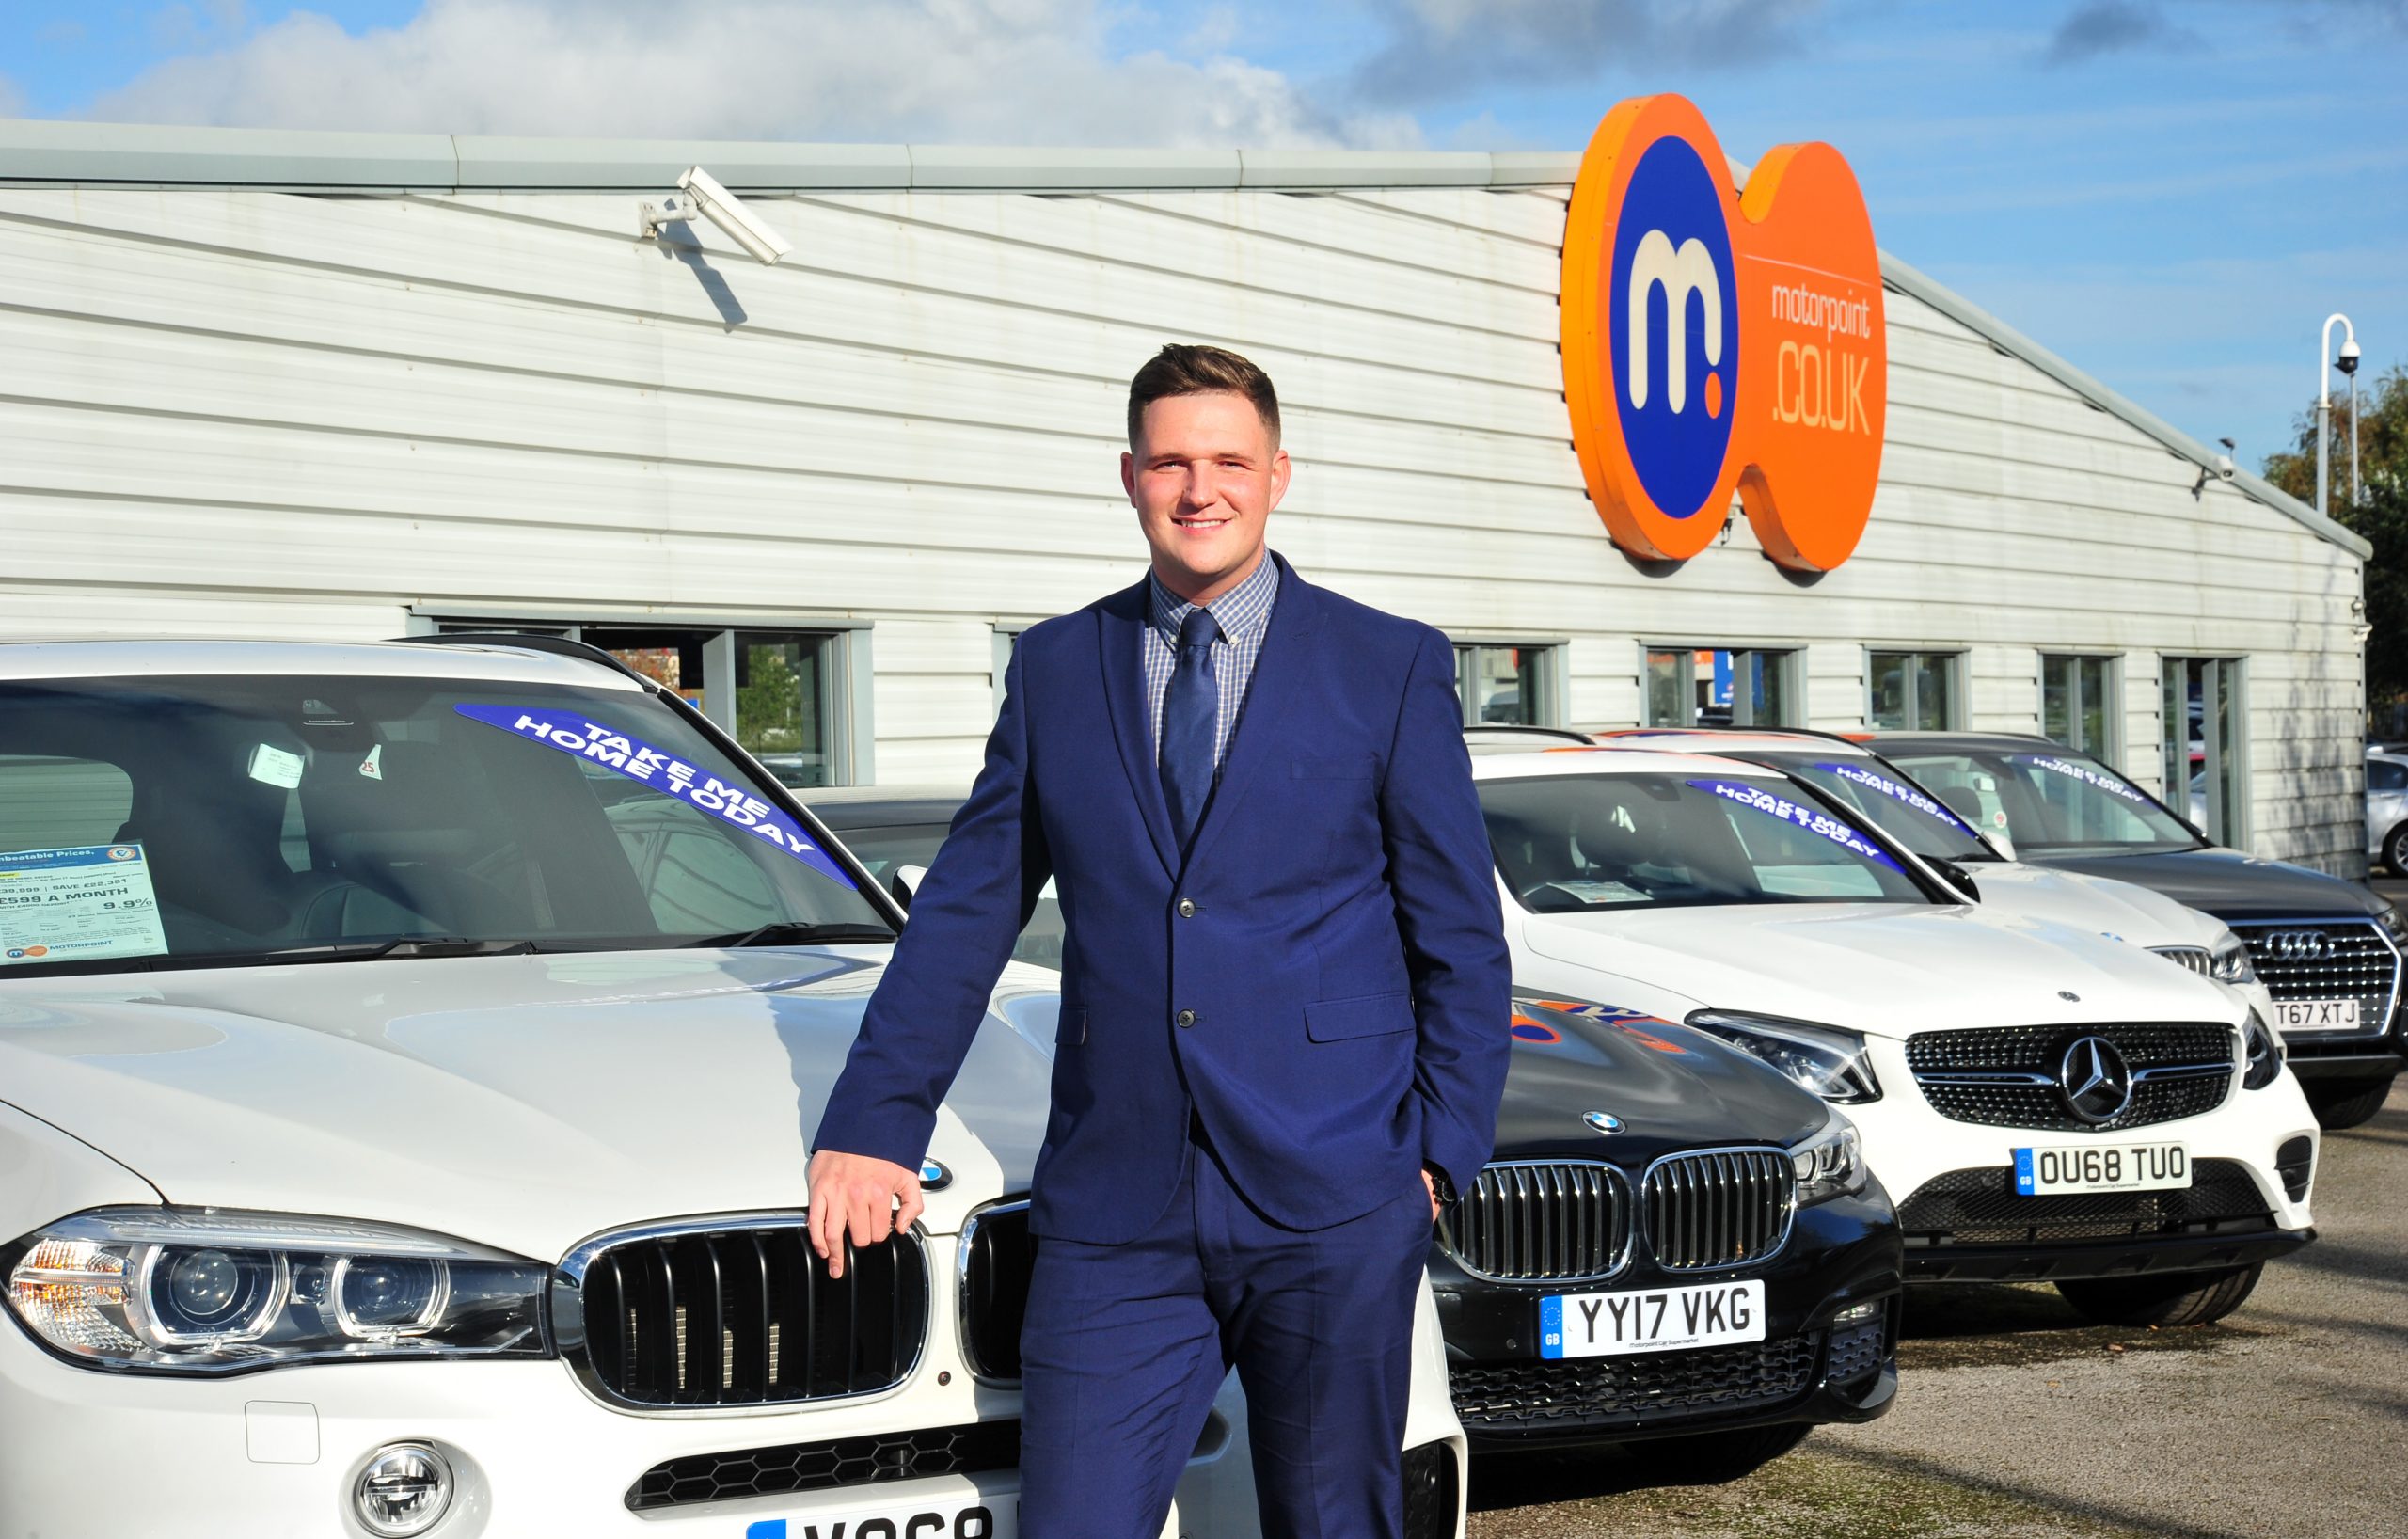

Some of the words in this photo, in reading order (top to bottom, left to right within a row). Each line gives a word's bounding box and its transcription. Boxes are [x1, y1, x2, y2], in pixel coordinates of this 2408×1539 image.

[1772, 283, 1871, 342] motorpoint
[514, 715, 656, 780] HOME
[667, 774, 816, 854] TODAY
[584, 722, 697, 782] TAKE
[704, 777, 770, 819] ME
[1715, 785, 1793, 820] HOME
[1797, 815, 1879, 857] TODAY
[1747, 787, 1810, 817] TAKE
[1815, 815, 1852, 837] ME
[65, 887, 129, 900] MONTH
[103, 898, 152, 910] 9.9%
[50, 940, 113, 950] MOTORPOINT
[2321, 1003, 2355, 1023] XTJ
[2020, 1176, 2032, 1185] GB
[2040, 1149, 2122, 1184] OU68
[2131, 1146, 2185, 1181] TUO
[1579, 1294, 1668, 1343] YY17
[1682, 1288, 1751, 1336] VKG
[1545, 1333, 1560, 1346] GB
